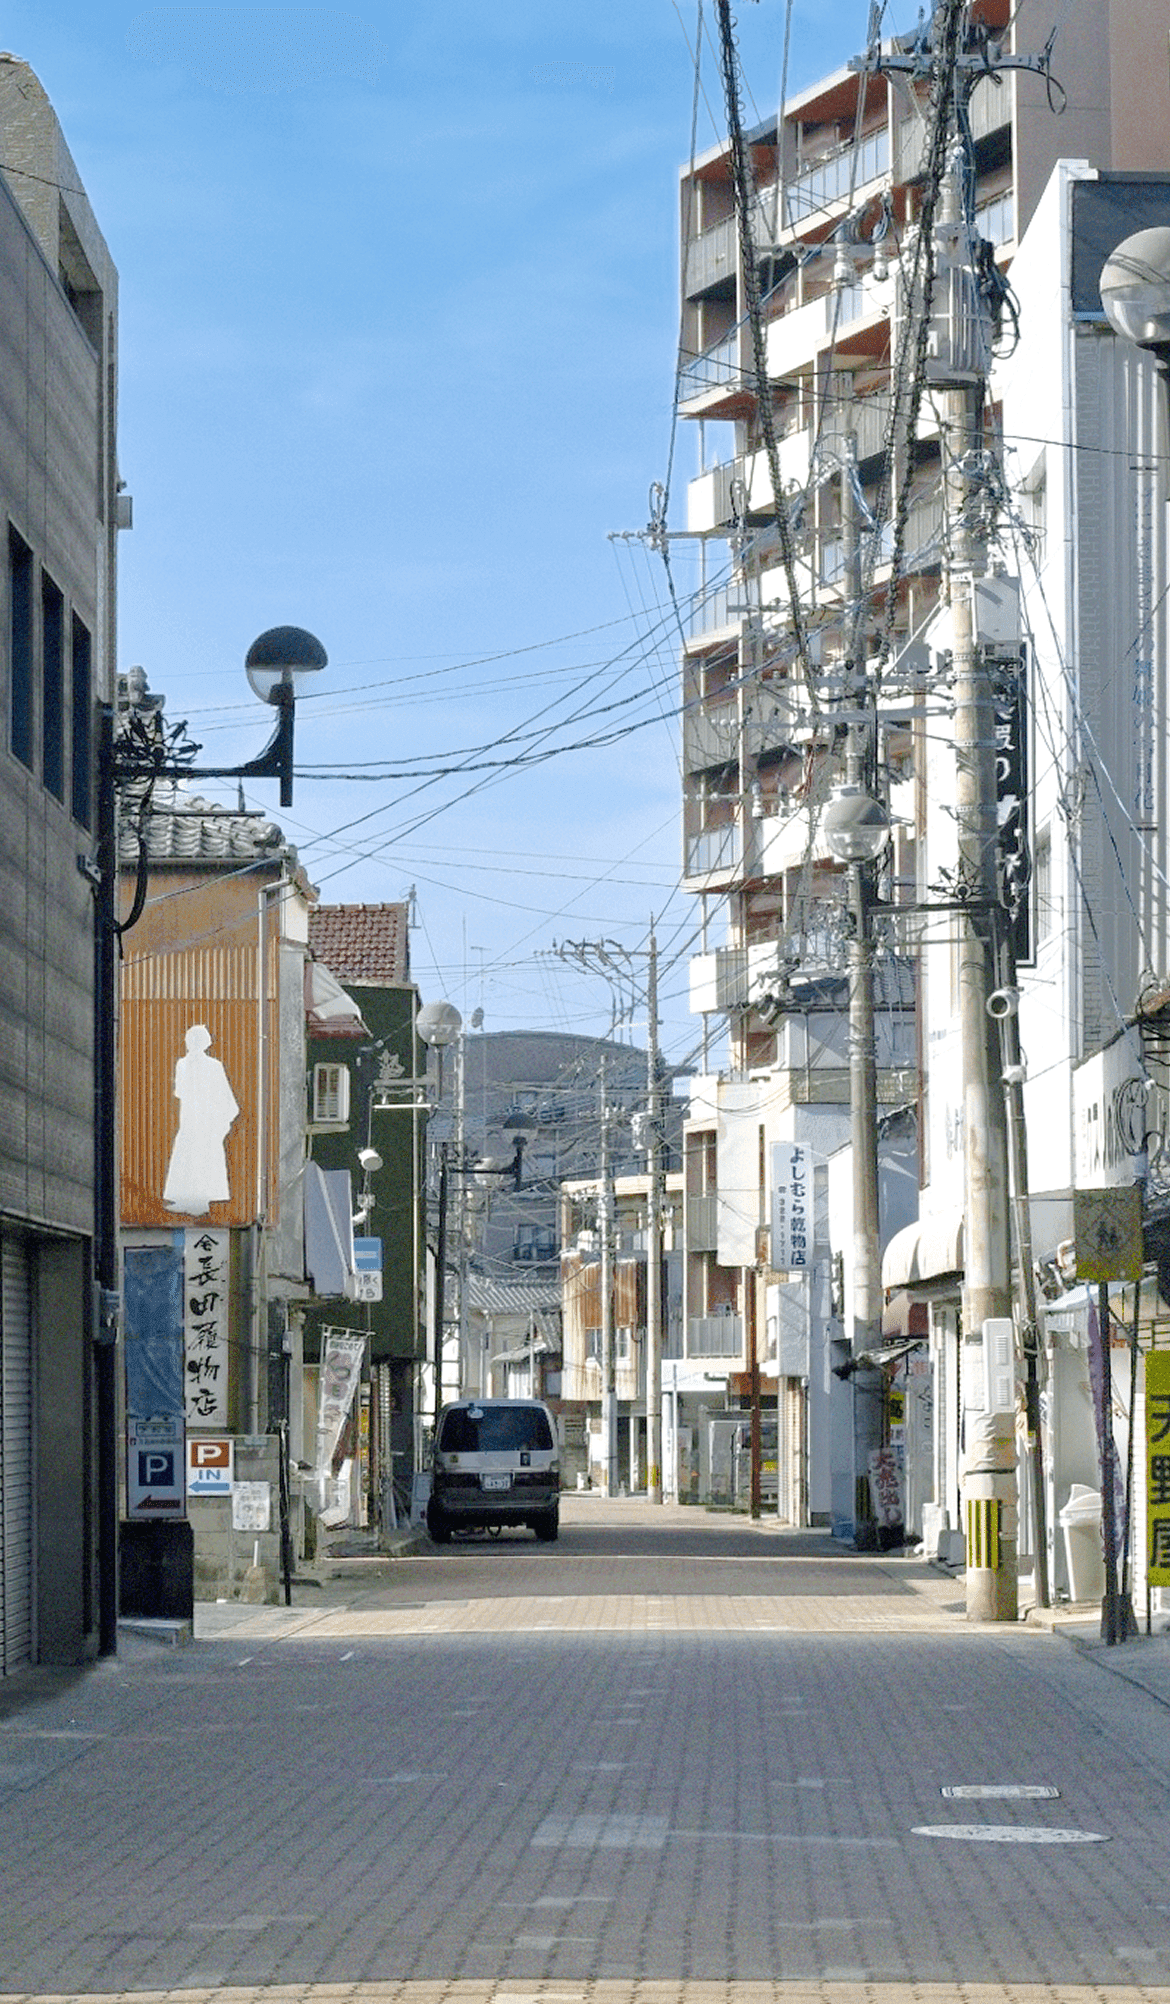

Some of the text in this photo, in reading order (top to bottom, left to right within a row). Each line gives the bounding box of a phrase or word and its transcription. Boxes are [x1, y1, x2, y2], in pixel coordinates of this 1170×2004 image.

[790, 1146, 806, 1265] よしむら乾物店
[196, 1445, 222, 1464] P
[146, 1455, 168, 1483] P
[198, 1469, 220, 1480] IN
